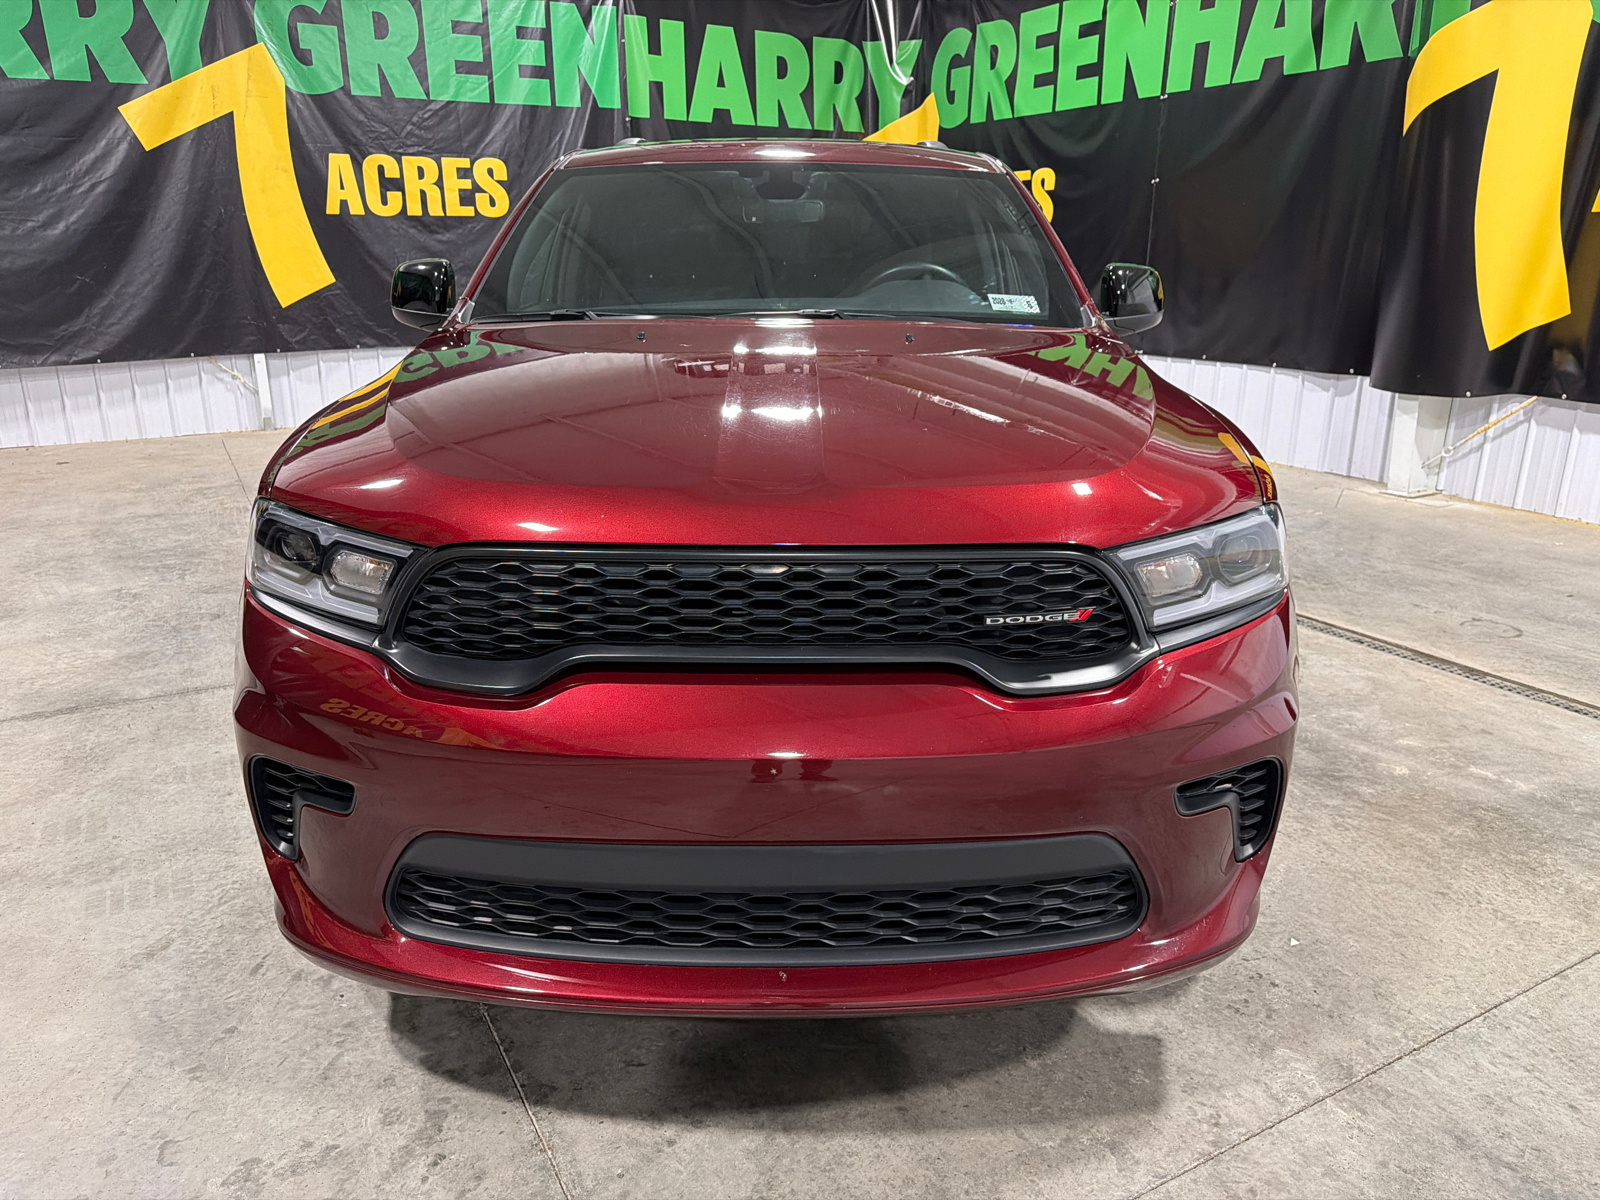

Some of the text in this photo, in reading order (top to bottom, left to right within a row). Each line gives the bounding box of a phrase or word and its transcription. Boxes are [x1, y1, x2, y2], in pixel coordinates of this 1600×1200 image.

[255, 0, 621, 109] GREEN
[623, 14, 922, 133] HARRY
[931, 0, 1172, 129] GREEN
[117, 42, 509, 308] 7 ACRES
[1403, 0, 1594, 351] 7
[985, 612, 1080, 625] DODGE
